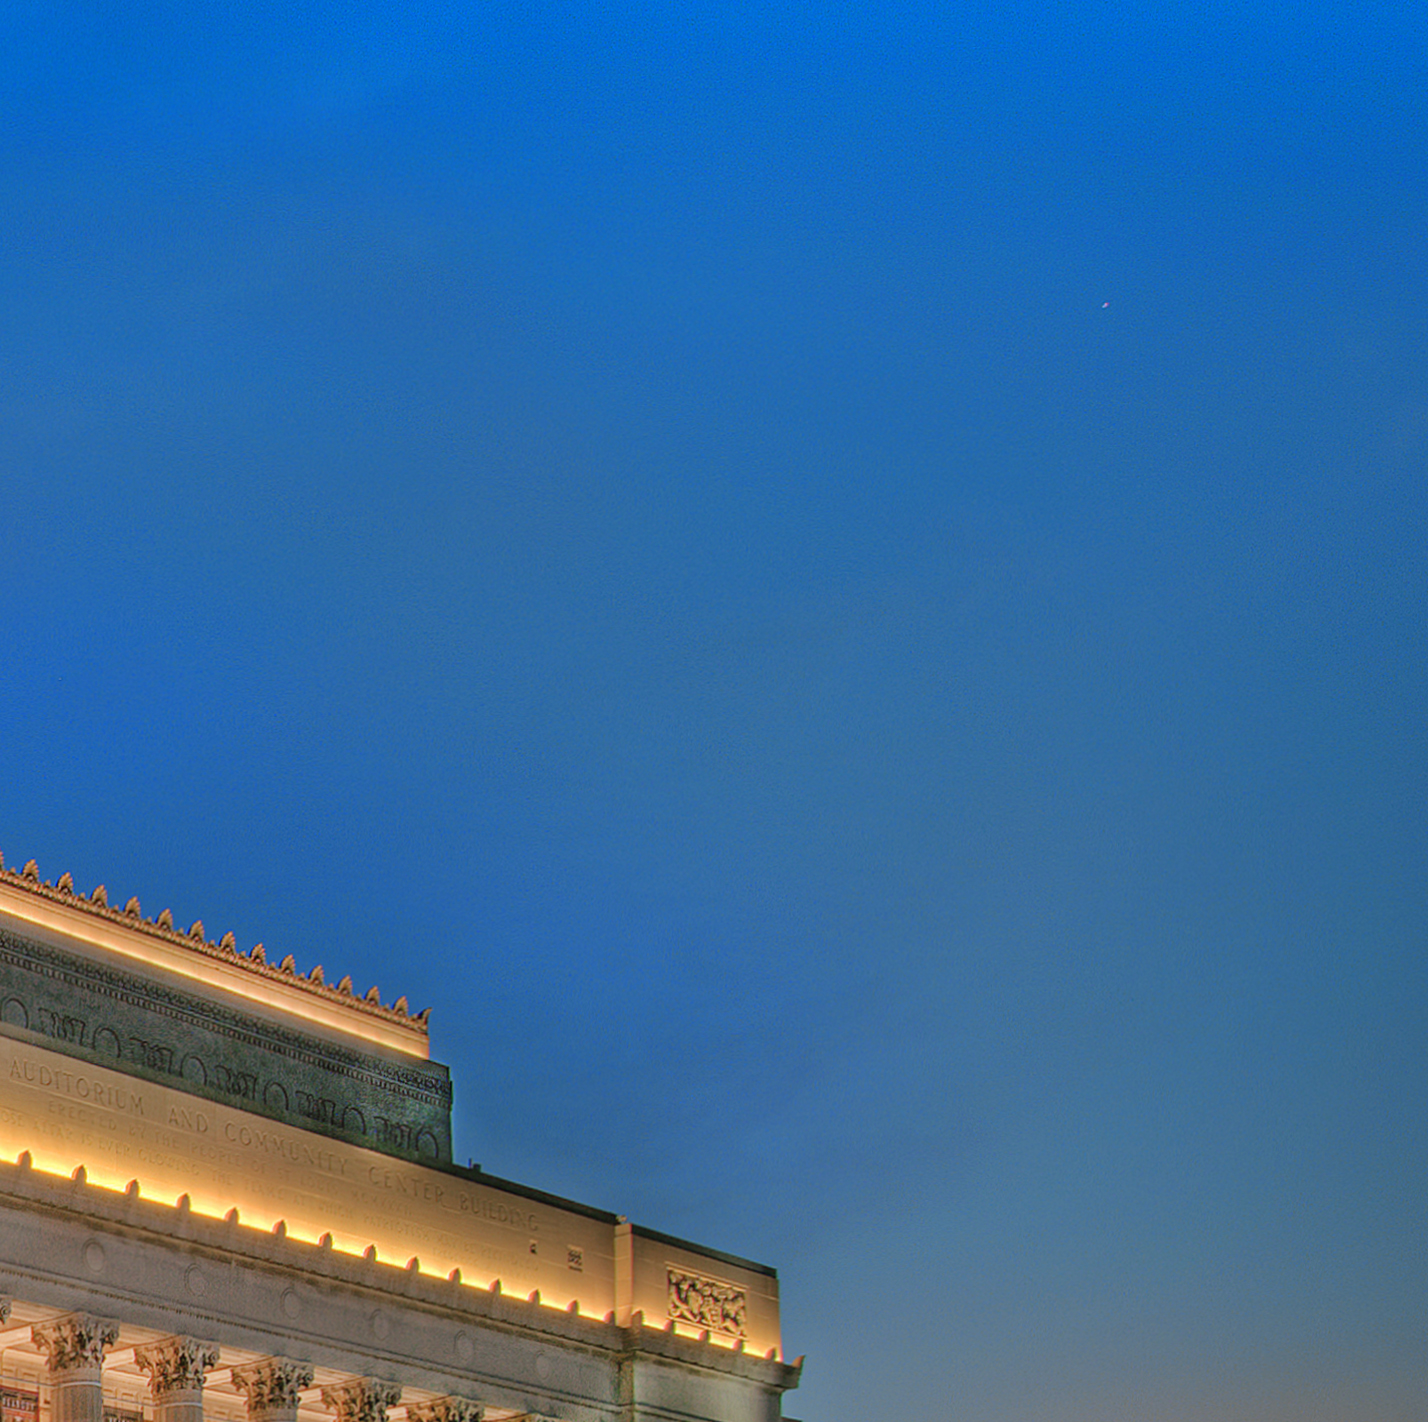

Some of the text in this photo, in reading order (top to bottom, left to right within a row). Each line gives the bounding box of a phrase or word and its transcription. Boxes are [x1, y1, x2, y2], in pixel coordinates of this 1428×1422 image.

[9, 1057, 144, 1115] AUDITORIUM
[168, 1105, 208, 1133] AND
[225, 1121, 347, 1175] COMMUNITY
[369, 1166, 443, 1203] CENTER
[460, 1192, 538, 1231] BUILDING
